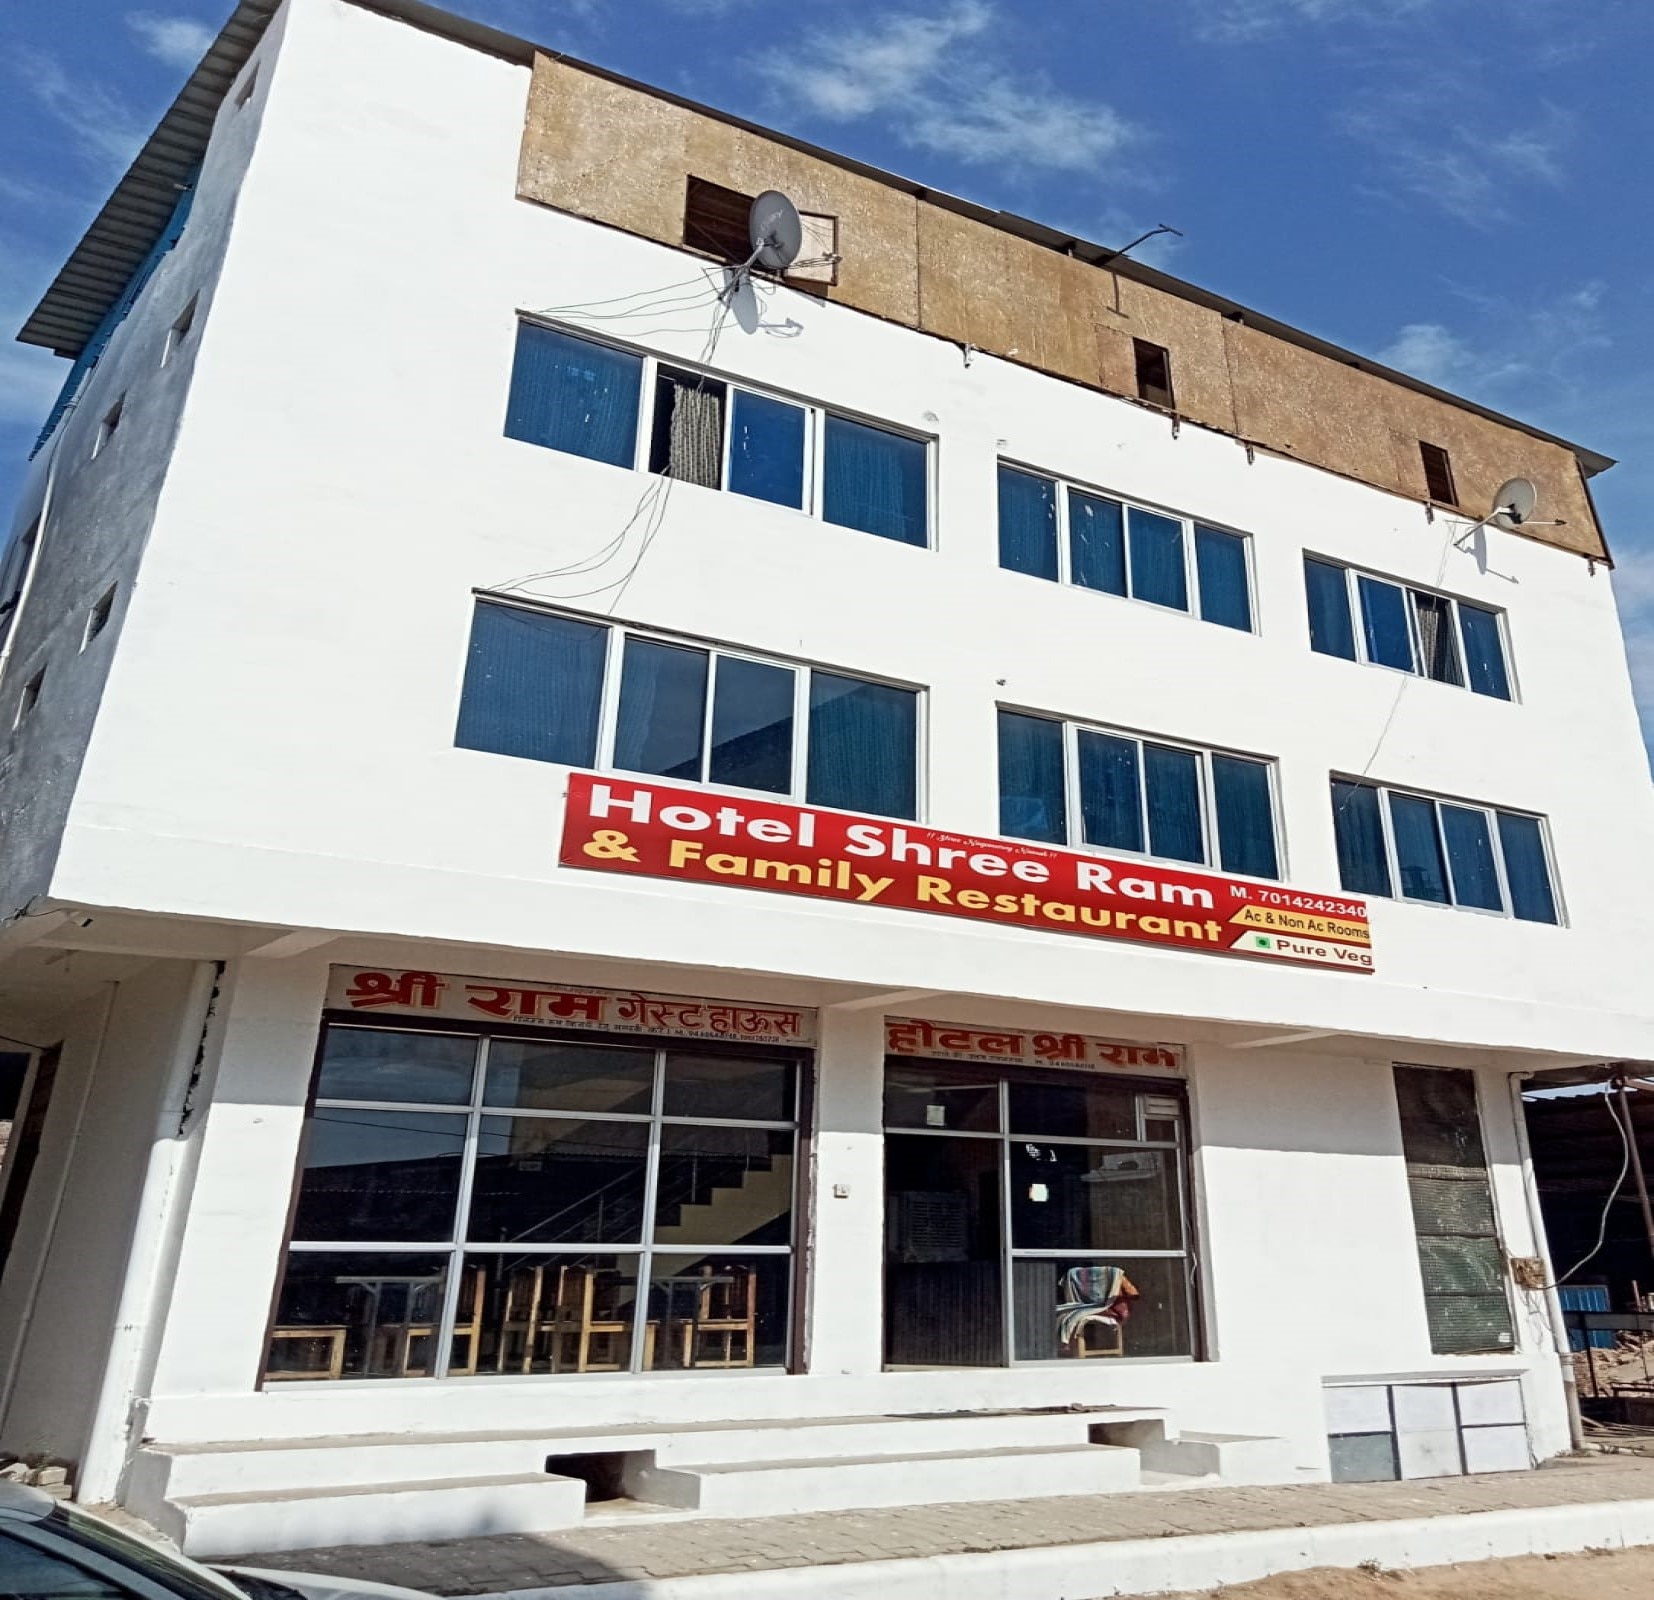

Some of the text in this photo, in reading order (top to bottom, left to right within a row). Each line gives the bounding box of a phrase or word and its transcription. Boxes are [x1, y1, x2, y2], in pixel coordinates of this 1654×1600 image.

[589, 783, 1215, 909] Hotel Shree Ram
[583, 829, 1223, 942] & Family Restaurant
[1229, 885, 1367, 918] M. 7014242340
[1244, 909, 1370, 940] Ac & Non Ac Rooms
[1276, 938, 1372, 966] Pure Veg
[346, 971, 446, 1009] श्री
[464, 983, 607, 1021] राम
[885, 1019, 1025, 1055] होटल
[1031, 1033, 1089, 1061] श्री
[1096, 1042, 1180, 1070] राम
